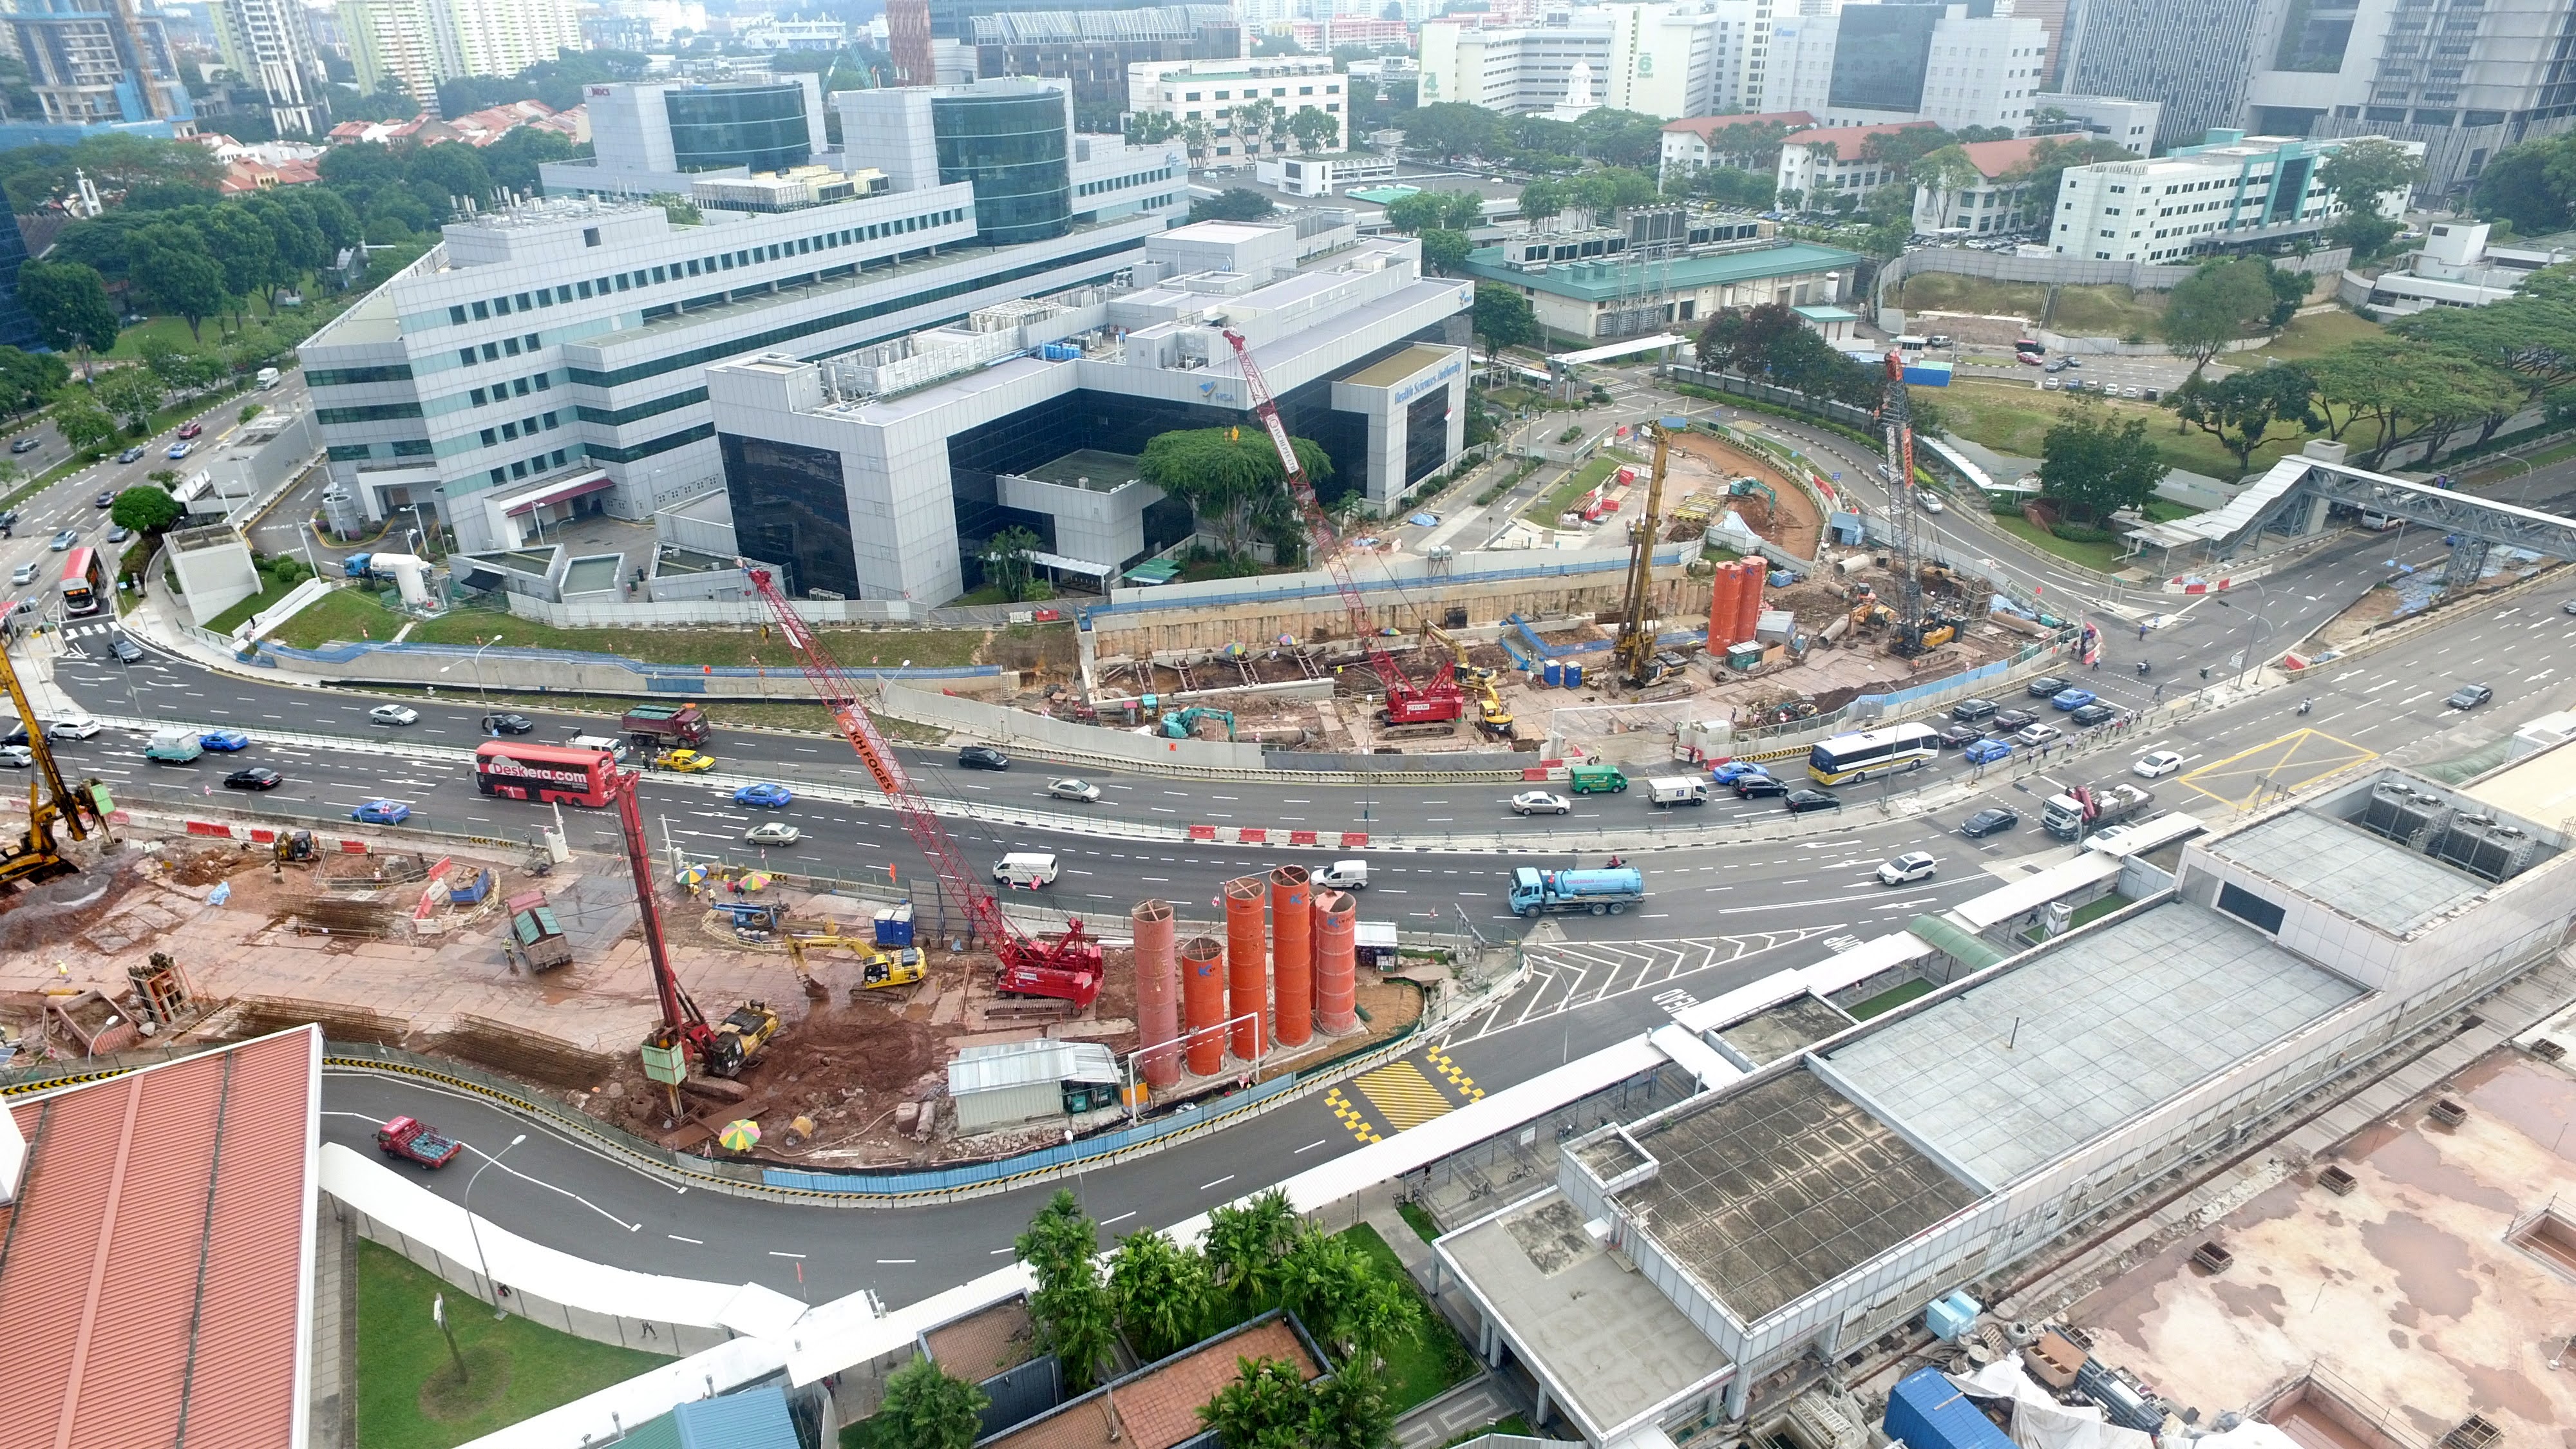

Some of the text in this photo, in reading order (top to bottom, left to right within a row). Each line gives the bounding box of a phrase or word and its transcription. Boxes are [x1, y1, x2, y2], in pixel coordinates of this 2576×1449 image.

[1638, 56, 1652, 71] 6
[1424, 73, 1439, 91] 4
[1395, 361, 1461, 404] Health Sciences Authority
[850, 732, 893, 790] KH FOGES
[493, 763, 587, 783] Deskera.com
